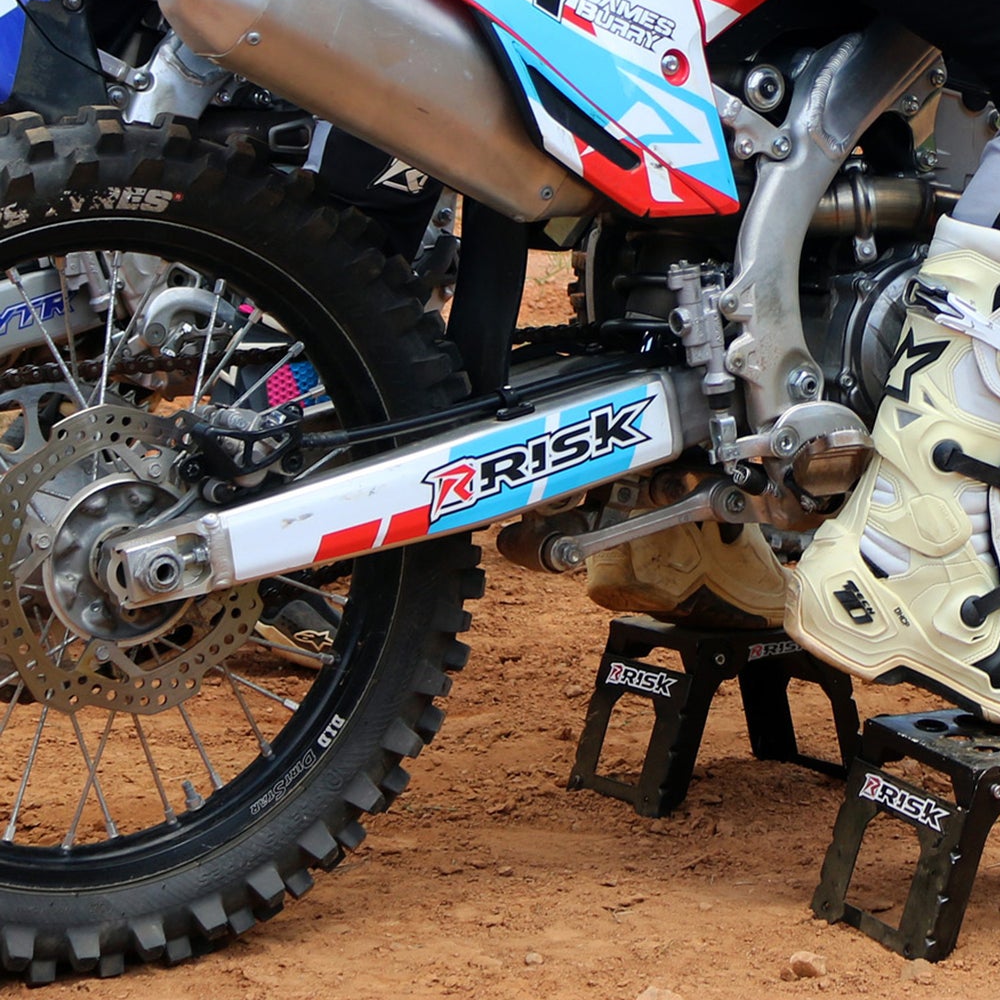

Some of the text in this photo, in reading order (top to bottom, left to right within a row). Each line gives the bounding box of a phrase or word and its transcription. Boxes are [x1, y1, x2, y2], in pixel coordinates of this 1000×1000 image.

[479, 399, 656, 493] RISK
[621, 666, 678, 698] RISK
[877, 783, 951, 833] RISK
